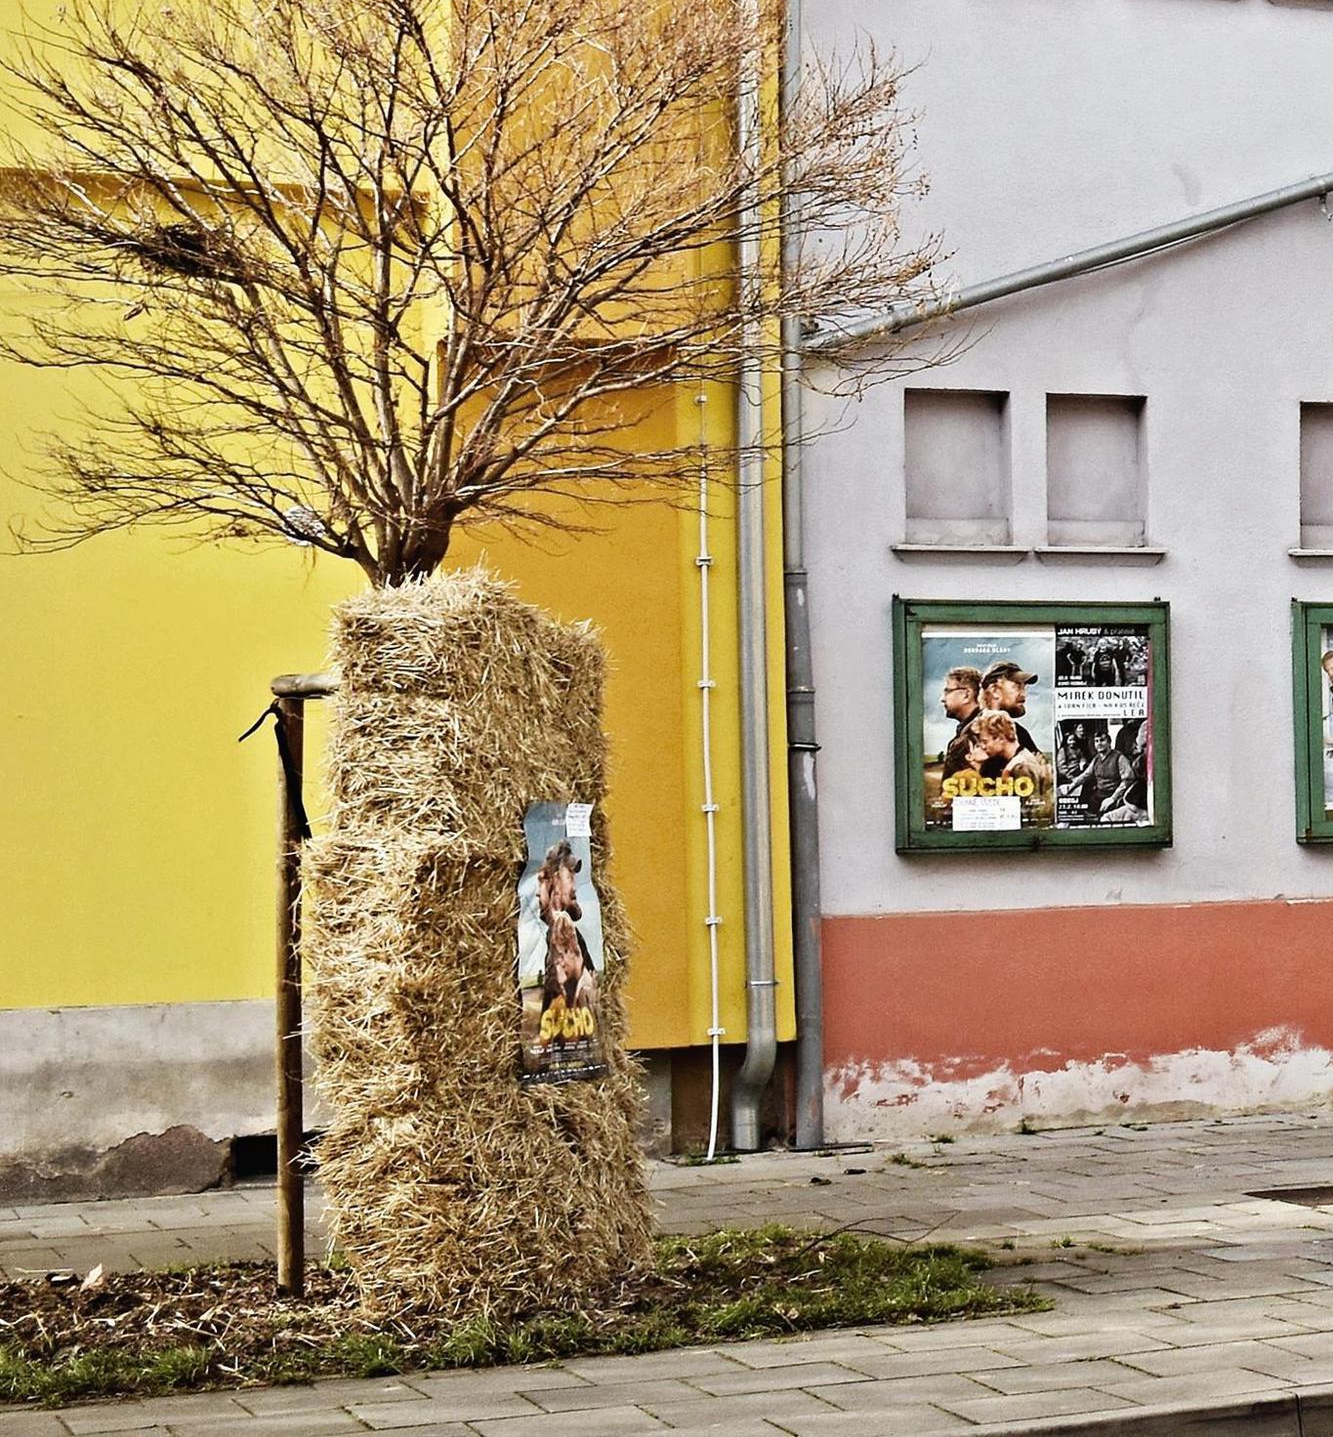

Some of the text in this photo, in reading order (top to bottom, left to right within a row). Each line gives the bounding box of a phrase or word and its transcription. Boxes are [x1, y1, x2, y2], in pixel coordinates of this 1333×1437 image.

[1057, 690, 1145, 700] MIREK DONUTIL
[942, 776, 1035, 798] SUCHO
